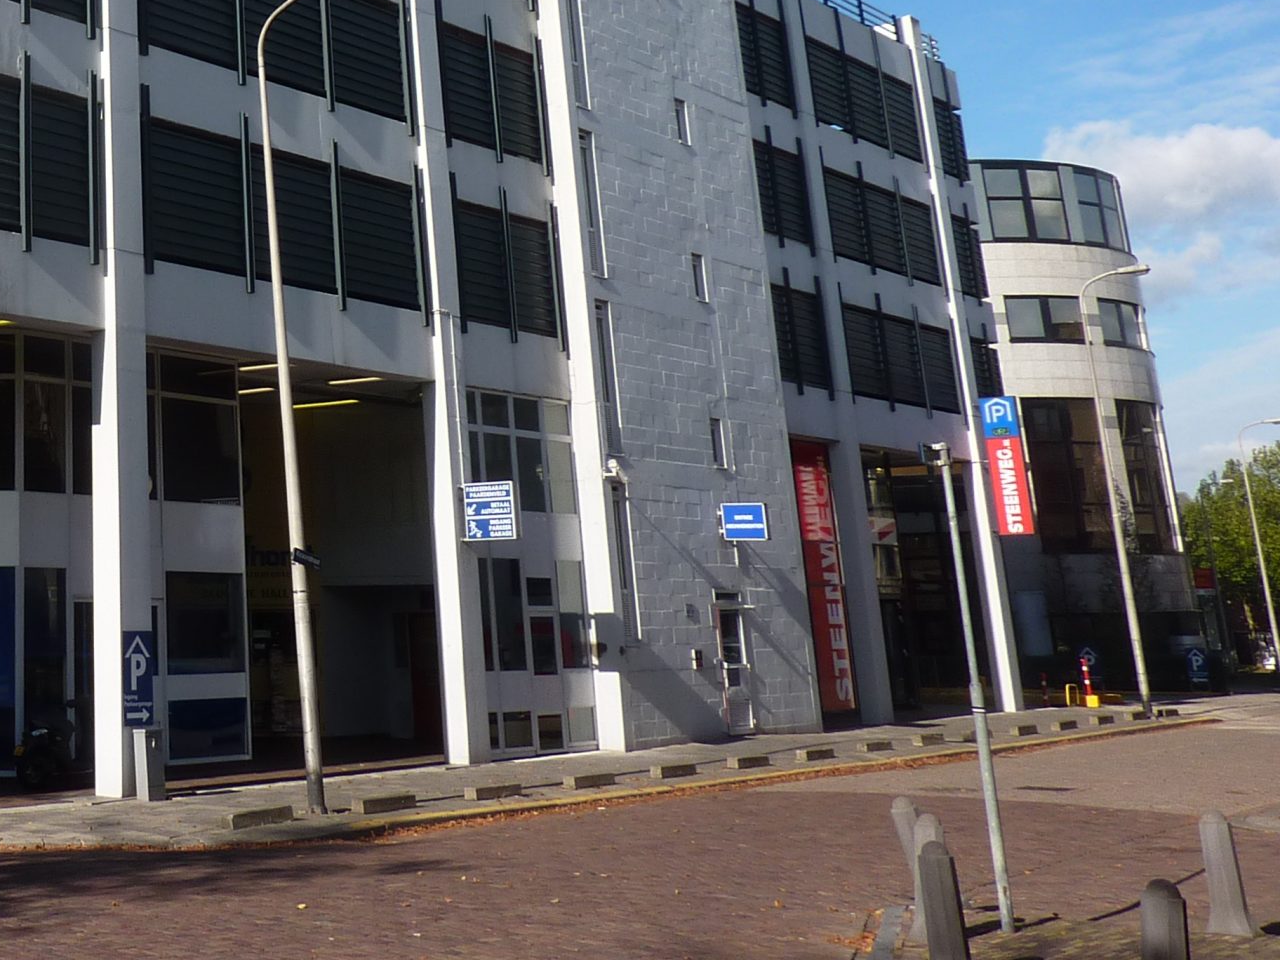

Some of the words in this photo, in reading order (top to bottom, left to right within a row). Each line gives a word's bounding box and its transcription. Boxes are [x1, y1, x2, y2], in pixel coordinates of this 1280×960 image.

[991, 406, 1005, 423] P
[130, 653, 147, 691] P
[1192, 656, 1203, 671] P
